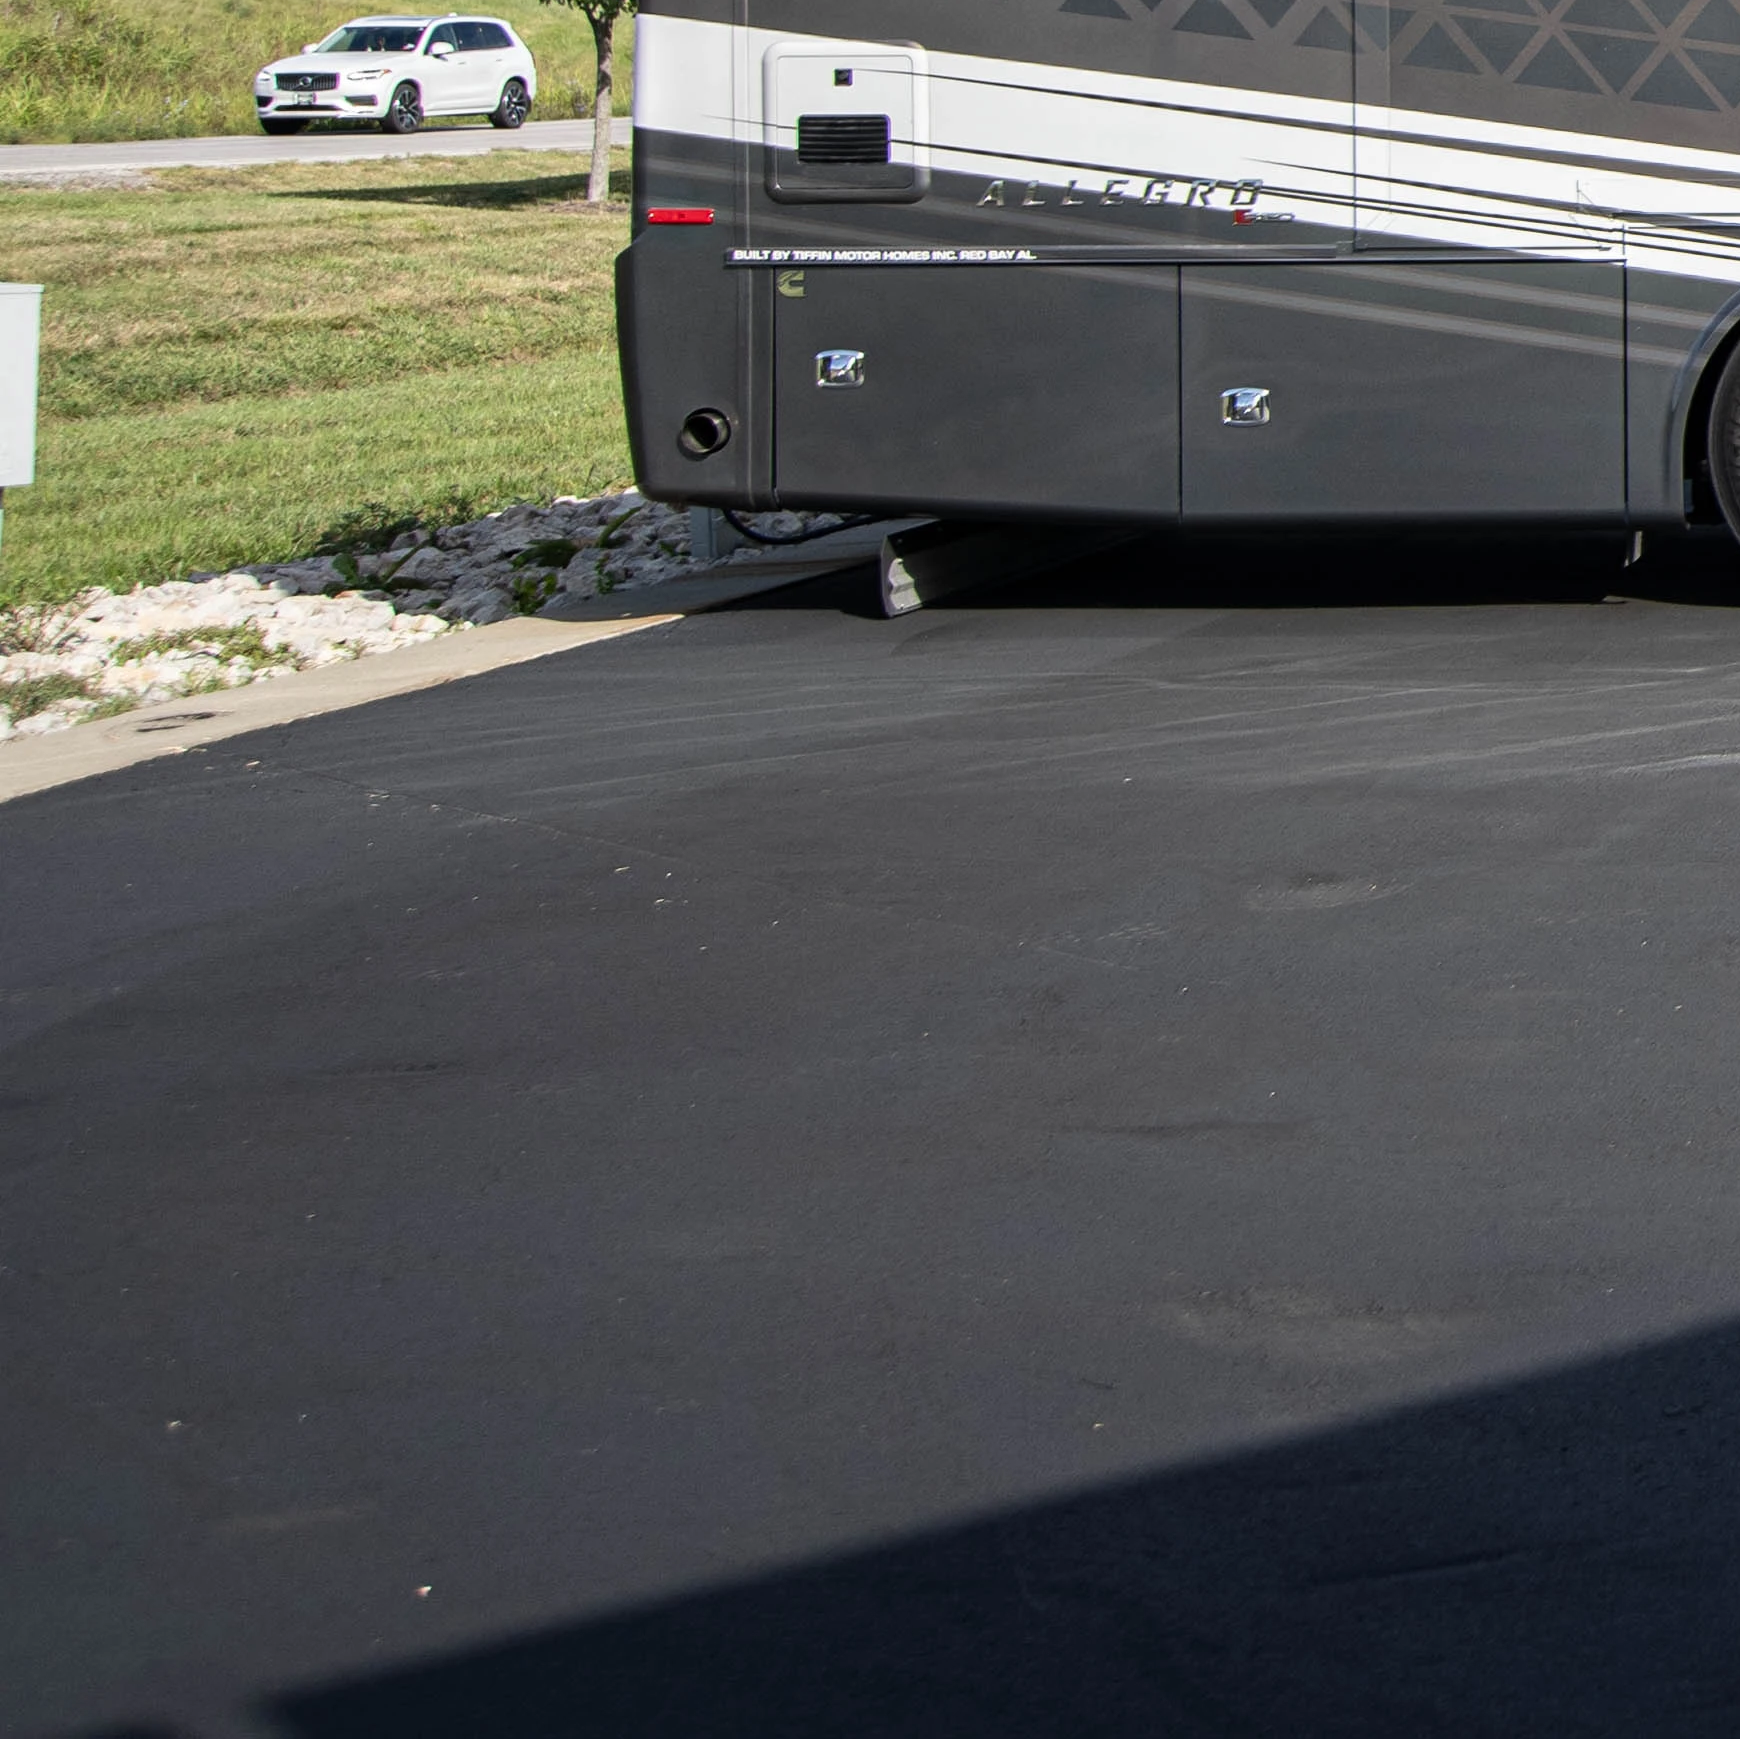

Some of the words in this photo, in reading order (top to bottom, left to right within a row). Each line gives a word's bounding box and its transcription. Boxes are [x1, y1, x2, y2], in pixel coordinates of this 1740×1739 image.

[976, 178, 1263, 207] ALLEGRO
[733, 250, 771, 260] BUILT
[771, 250, 791, 260] BY
[792, 250, 832, 260] TIFFIN
[833, 250, 881, 260] MOTOR
[882, 250, 930, 260] HOMES
[931, 250, 958, 260] INC.
[959, 250, 986, 260] RED
[988, 250, 1015, 260] BAY
